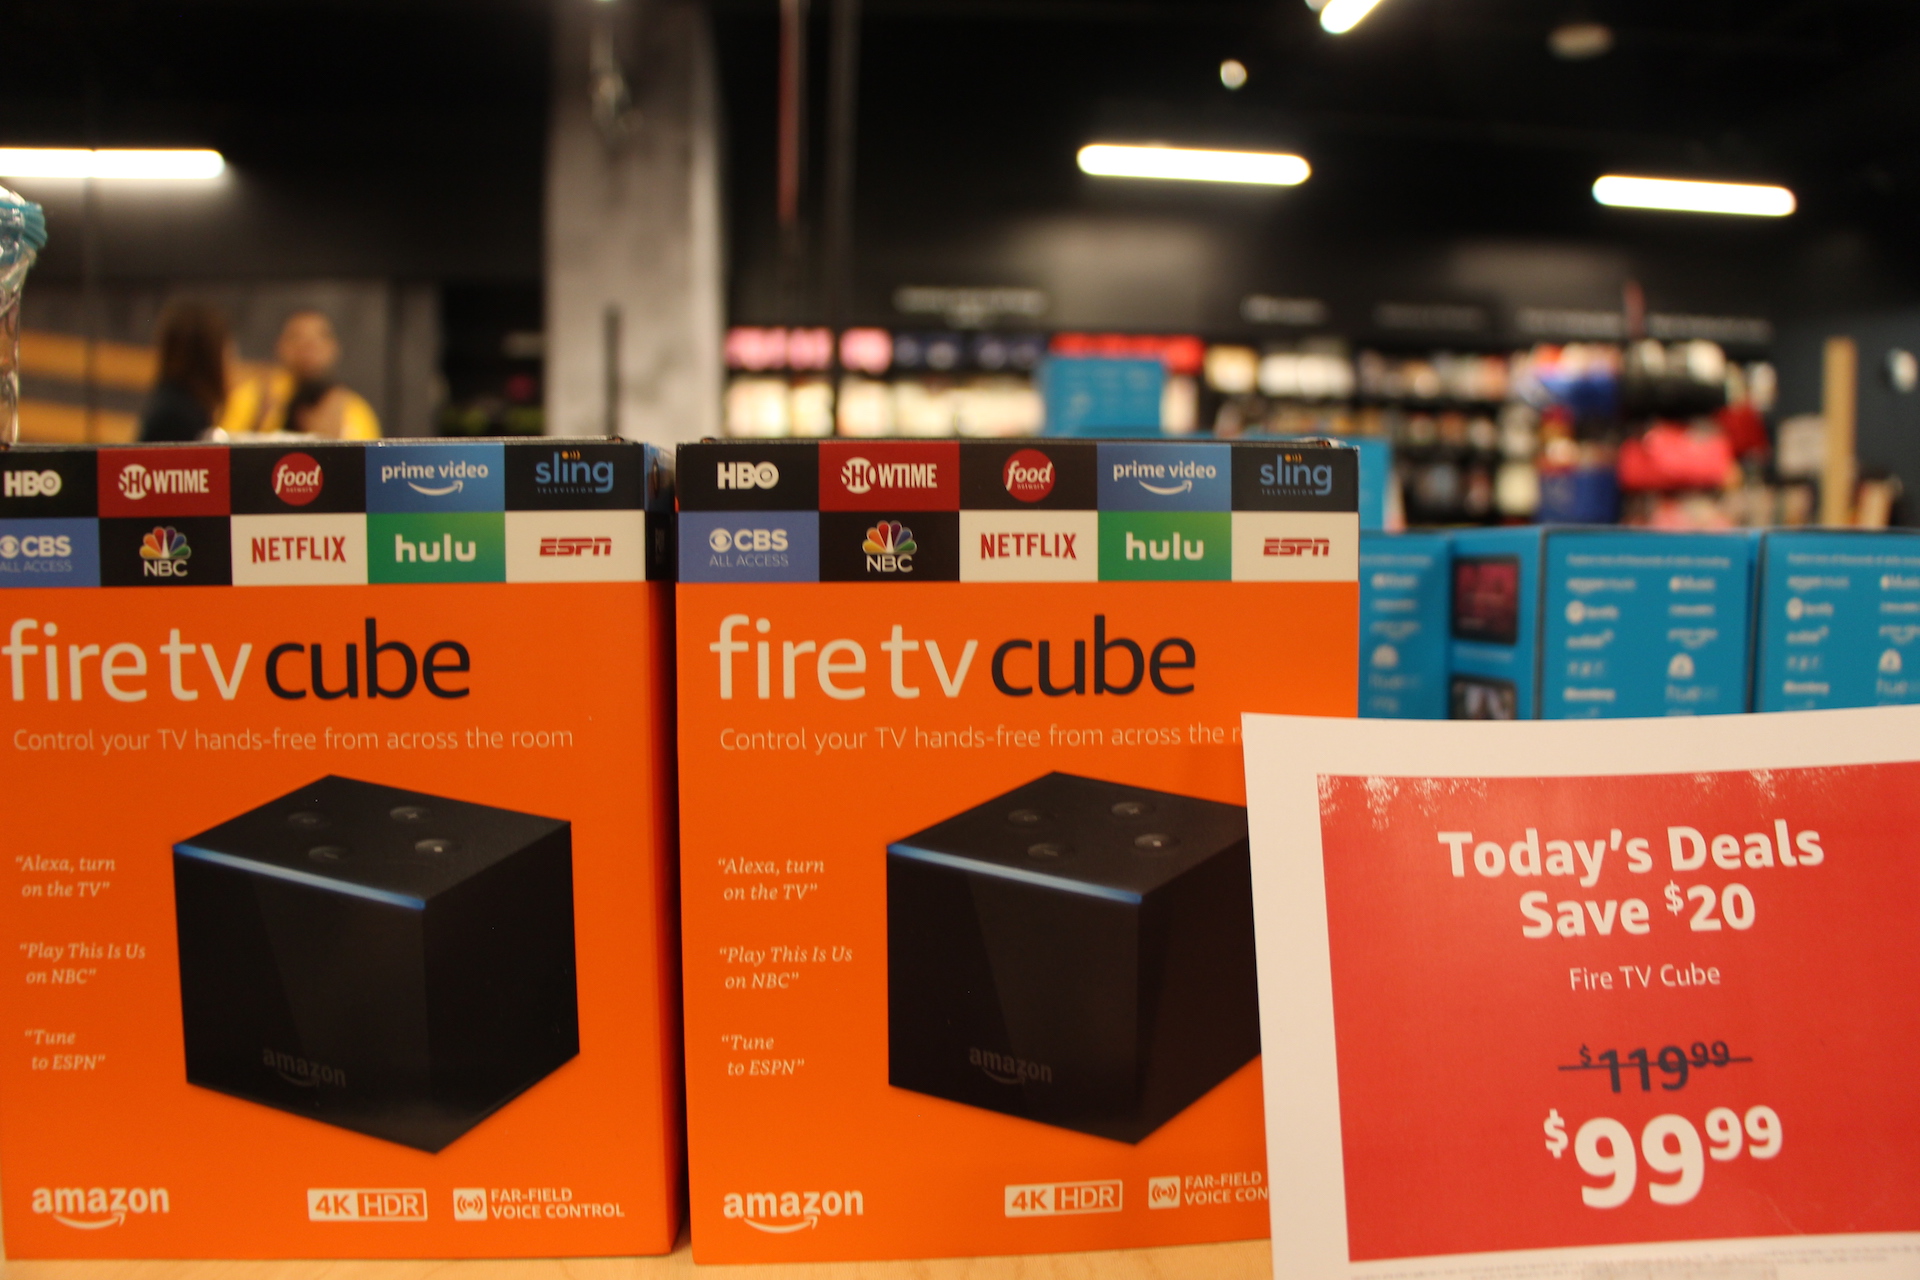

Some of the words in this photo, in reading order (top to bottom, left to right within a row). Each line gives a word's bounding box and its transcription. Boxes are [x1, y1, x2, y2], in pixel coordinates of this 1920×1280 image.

[118, 464, 209, 500] SHOWTIME
[275, 464, 321, 495] food
[381, 461, 435, 483] prime
[439, 460, 489, 478] video
[535, 451, 614, 493] sling
[717, 461, 780, 490] HBO
[840, 457, 938, 494] SHOWTIME
[1005, 460, 1053, 491] food
[1113, 460, 1164, 482] prime
[1168, 460, 1217, 478] video
[1259, 454, 1332, 496] sling
[4, 470, 62, 497] HBO
[21, 535, 72, 557] CBS
[252, 536, 346, 564] NETFLIX
[395, 533, 476, 563] hulu
[539, 537, 612, 556] ESPN
[734, 529, 789, 551] CBS
[980, 532, 1077, 560] NETFLIX
[1125, 531, 1204, 561] hulu
[1263, 537, 1330, 557] ESPN
[24, 560, 72, 573] ACCESS
[144, 560, 188, 577] NBC
[709, 554, 732, 567] ALL
[736, 554, 789, 567] ACCESS
[866, 554, 914, 573] NBC
[1, 618, 148, 702] fire
[159, 628, 253, 702] tv
[265, 616, 470, 701] cube
[709, 613, 867, 701] fire
[880, 624, 979, 698] tv
[991, 613, 1196, 696] cube
[13, 729, 94, 751] Control
[101, 732, 151, 756] your
[157, 729, 187, 750] TV
[195, 727, 316, 750] hands-free
[324, 727, 379, 749] from
[387, 731, 458, 750] across
[466, 726, 504, 748] the
[511, 729, 573, 748] room
[720, 727, 806, 750] Control
[814, 731, 868, 756] your
[874, 726, 907, 748] TV
[915, 724, 1040, 748] hands-free
[1049, 723, 1103, 746] from
[1111, 726, 1181, 746] across
[1188, 722, 1225, 744] the
[79, 856, 116, 872] turn
[1437, 828, 1653, 888] Today’s
[1666, 818, 1825, 872] Deals
[786, 859, 825, 874] turn
[21, 885, 43, 897] on
[47, 882, 73, 897] the
[723, 888, 746, 901] on
[750, 884, 778, 901] the
[1519, 891, 1651, 939] Save
[1664, 880, 1756, 932] $20
[68, 943, 104, 959] This
[107, 944, 122, 959] Is
[125, 944, 146, 960] Us
[770, 945, 808, 962] This
[812, 946, 827, 962] Is
[831, 946, 853, 962] Us
[26, 971, 47, 984] on
[725, 976, 747, 989] on
[1569, 966, 1614, 992] Fire
[1619, 965, 1652, 990] TV
[1660, 962, 1721, 988] Cube
[31, 1057, 49, 1071] to
[263, 1048, 346, 1088] amazon
[727, 1060, 744, 1076] to
[969, 1046, 1053, 1084] amazon
[1184, 1171, 1262, 1189] FAR-FIELD
[32, 1186, 170, 1214] amazon
[315, 1194, 351, 1215] 4K
[364, 1195, 419, 1216] HDR
[490, 1188, 573, 1203] FAR-FIELD
[723, 1190, 864, 1219] amazon
[1011, 1188, 1048, 1211] 4K
[1061, 1185, 1115, 1210] HDR
[1184, 1190, 1231, 1206] VOICE
[491, 1205, 542, 1219] VOICE
[545, 1203, 625, 1218] CONTROL
